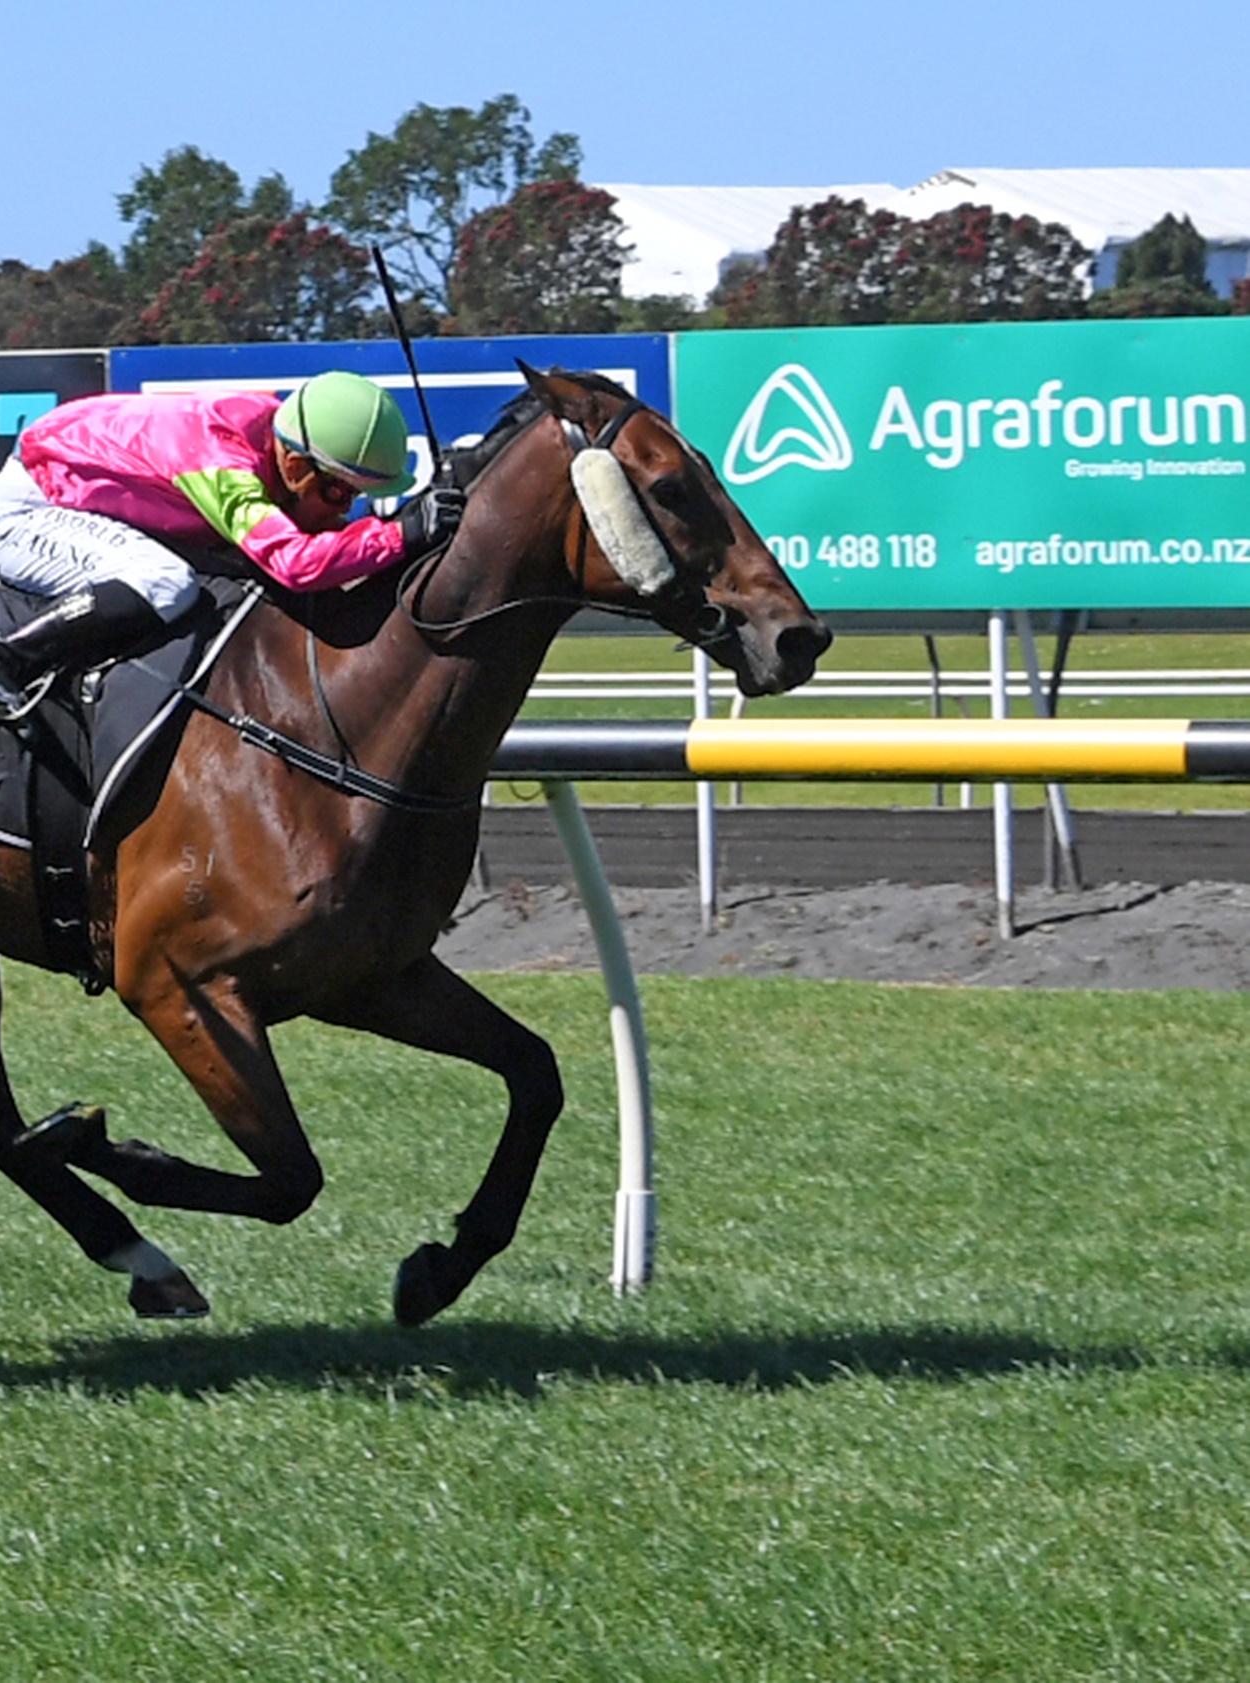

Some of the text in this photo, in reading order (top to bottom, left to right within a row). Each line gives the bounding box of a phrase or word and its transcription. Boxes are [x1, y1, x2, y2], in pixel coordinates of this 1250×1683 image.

[868, 379, 1247, 469] Agraforum
[1064, 458, 1246, 481] Growing Innovation
[816, 534, 881, 569] 488
[886, 534, 937, 569] 118
[975, 533, 1250, 573] agraforum.co.nz
